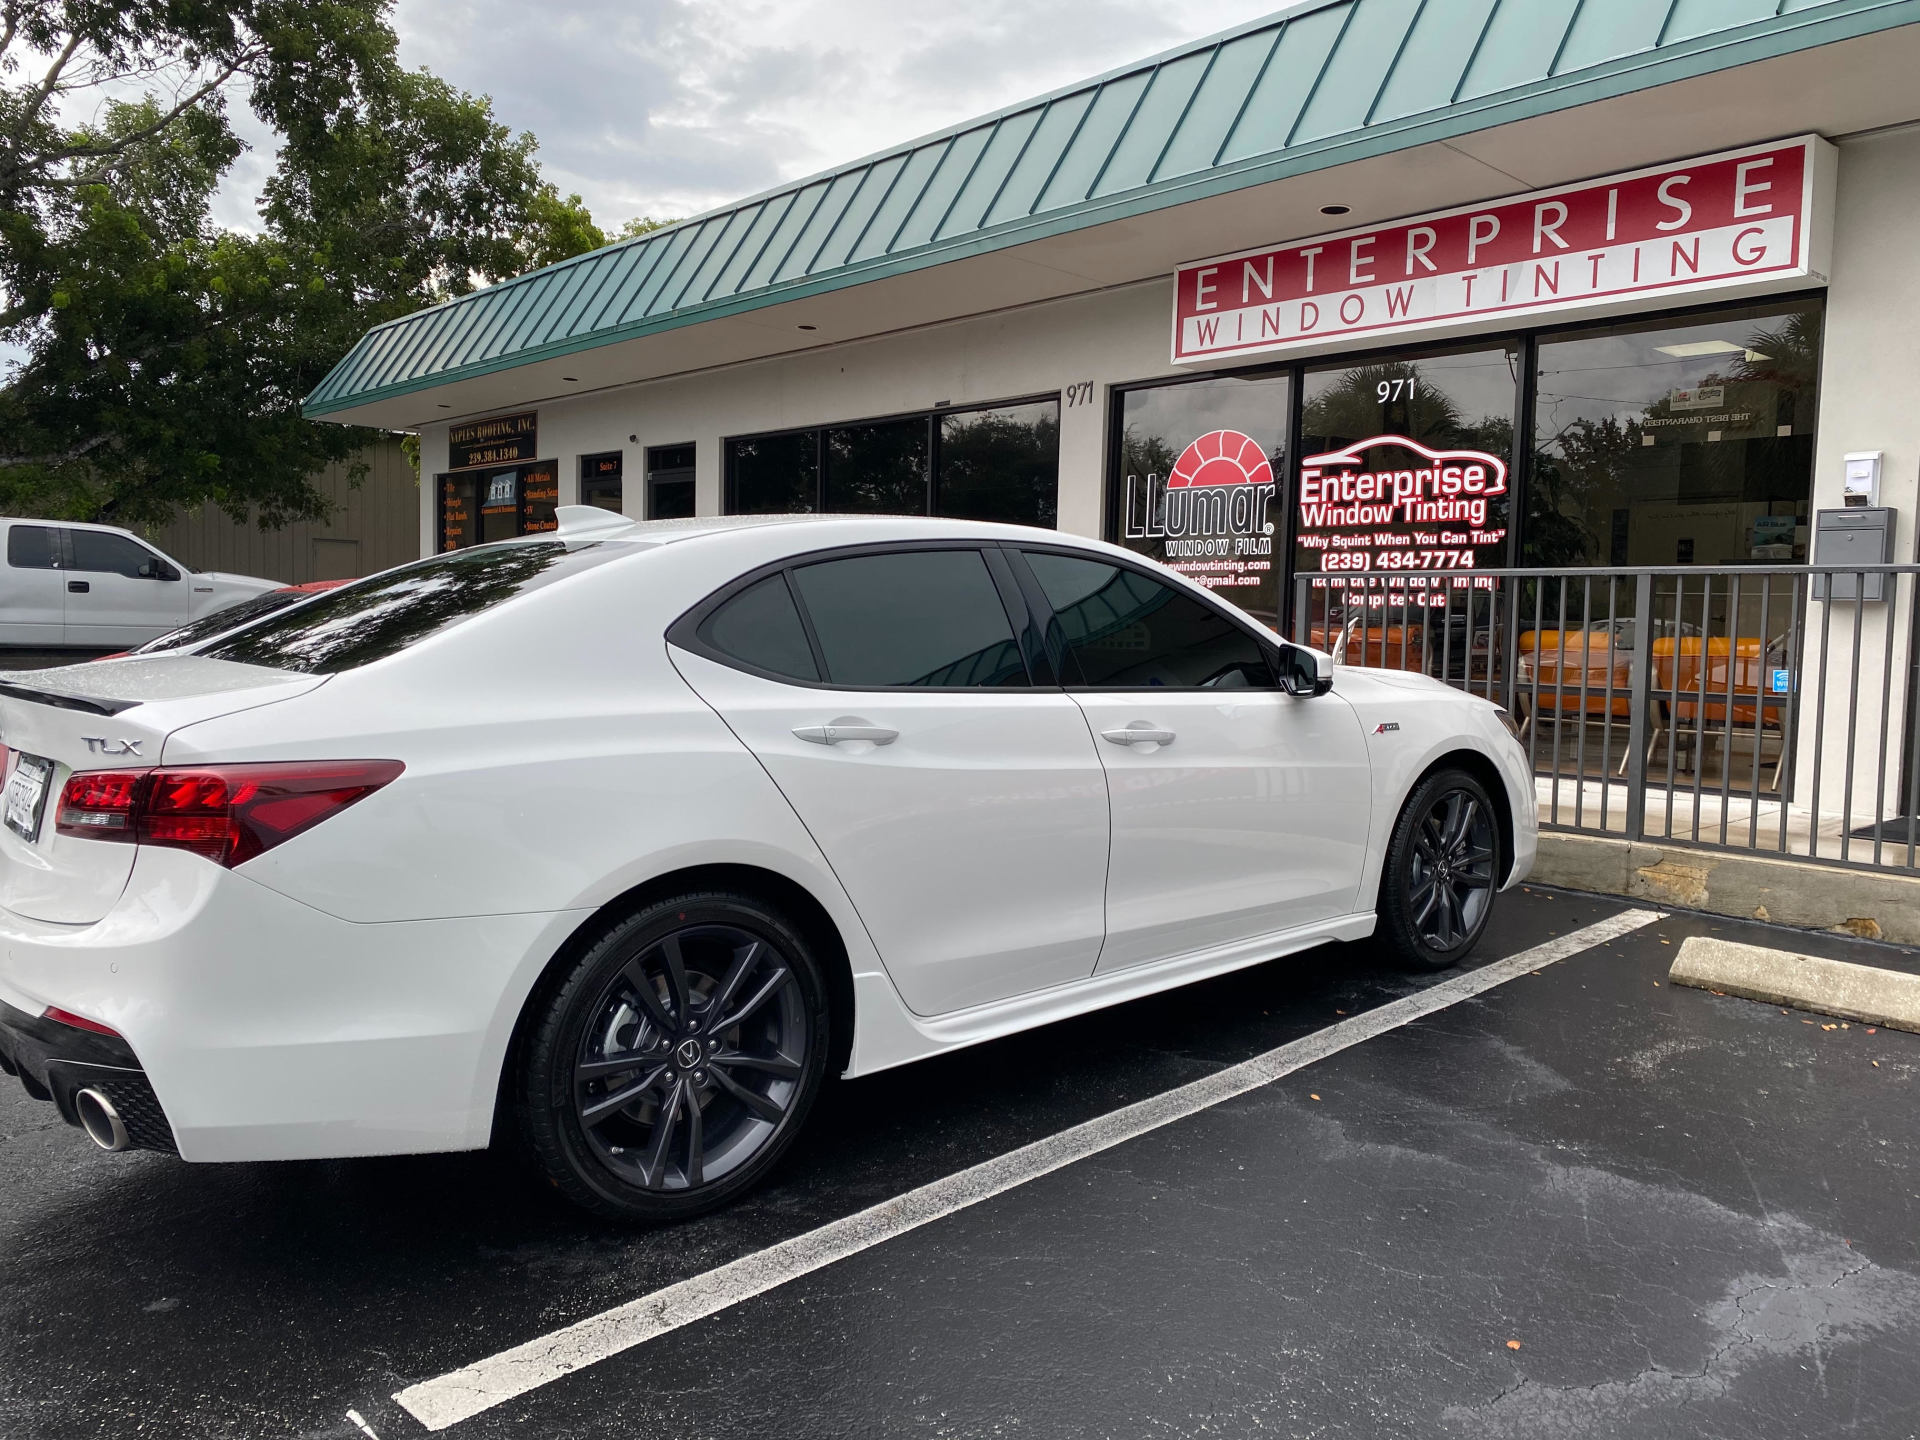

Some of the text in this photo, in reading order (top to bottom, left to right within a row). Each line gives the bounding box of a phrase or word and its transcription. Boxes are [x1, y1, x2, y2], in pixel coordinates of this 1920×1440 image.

[1195, 157, 1774, 312] ENTERPRISE
[1196, 227, 1768, 347] WINDOW TINTING
[1066, 380, 1094, 408] 971
[1377, 378, 1415, 404] 971
[450, 430, 475, 443] NAPLES
[1300, 459, 1486, 506] Enterprise
[1301, 495, 1487, 528] Window Tinting
[1165, 537, 1272, 557] WINDOW FILM
[1332, 534, 1371, 549] Squint
[1374, 532, 1411, 546] When
[1414, 531, 1437, 545] You
[1441, 531, 1467, 545] Can
[1321, 550, 1475, 572] (239) 434-7774
[80, 737, 143, 756] TLX
